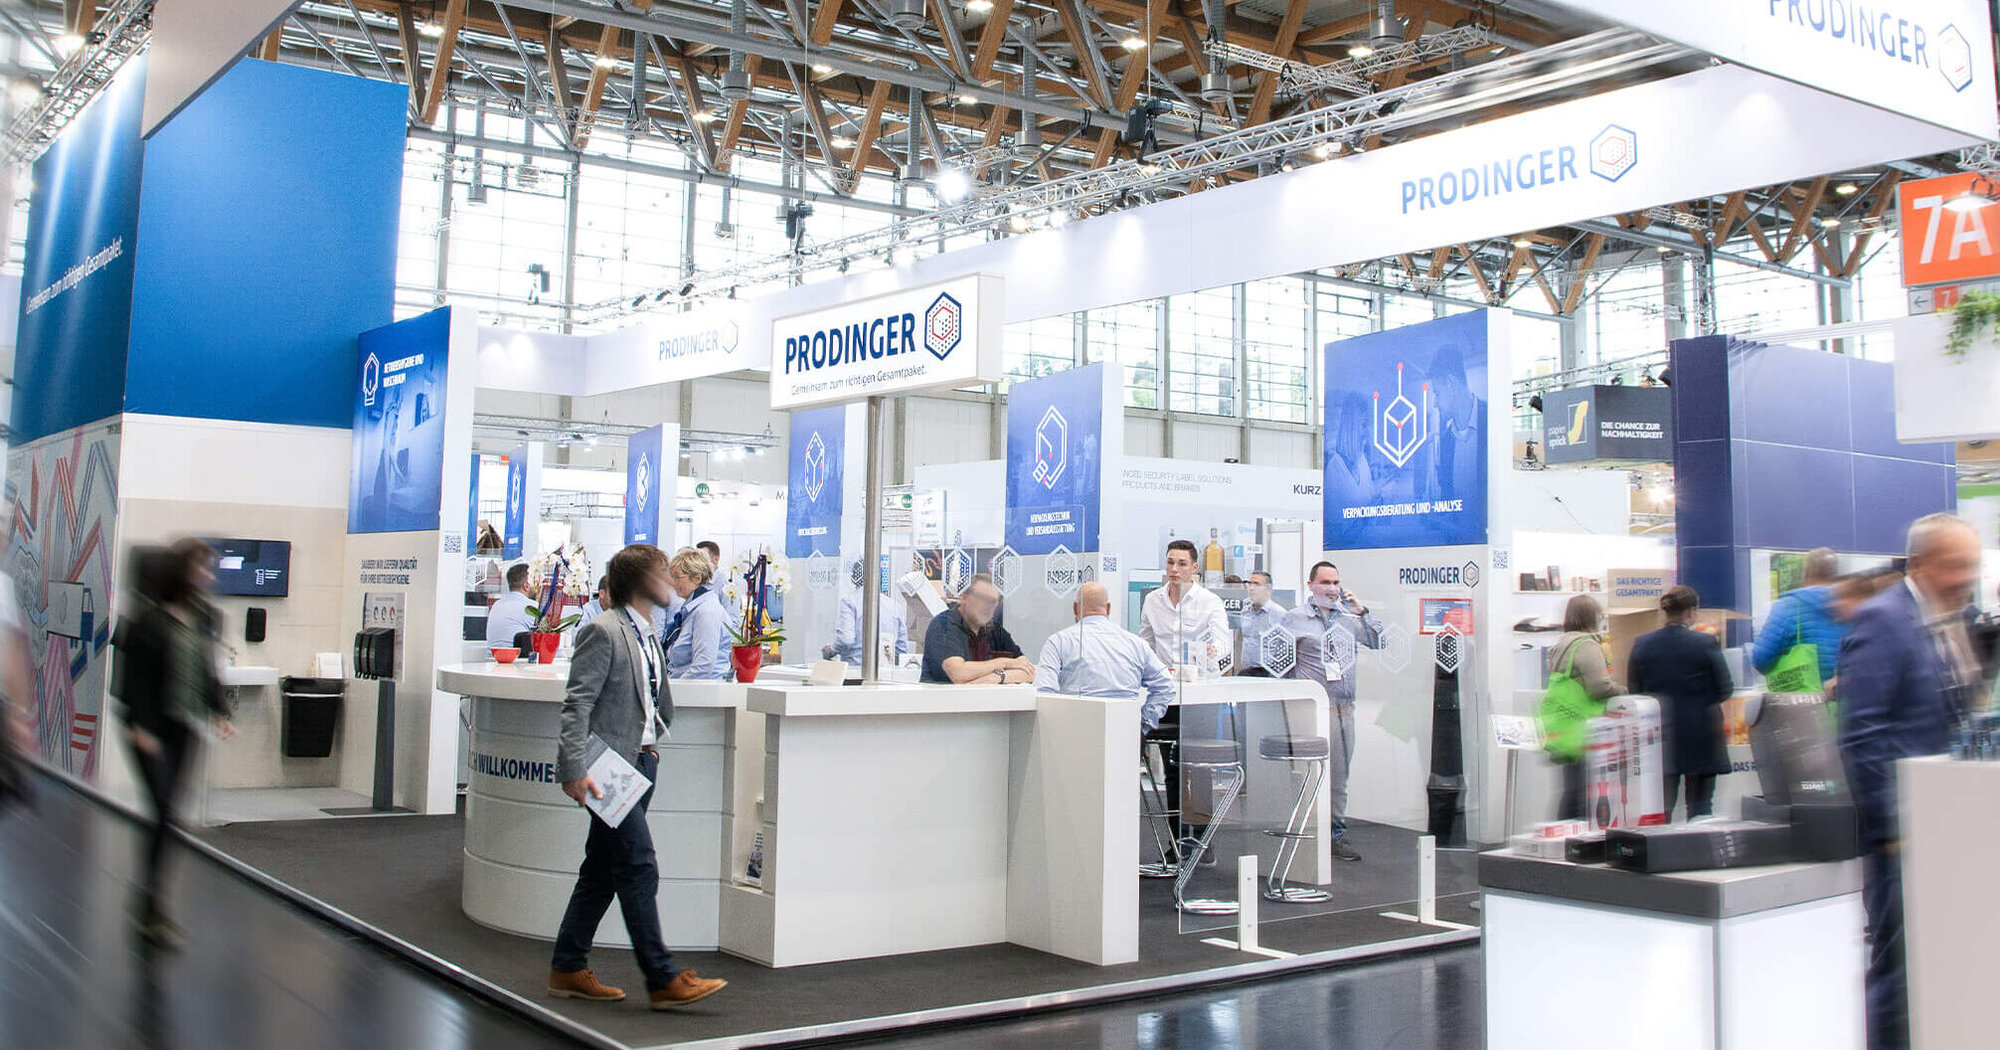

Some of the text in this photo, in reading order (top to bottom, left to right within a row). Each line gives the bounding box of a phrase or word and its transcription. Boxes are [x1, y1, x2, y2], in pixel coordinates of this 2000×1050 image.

[1402, 145, 1578, 215] PRODINGER
[1913, 195, 1993, 264] 7A
[659, 330, 719, 361] PRODINGER
[785, 312, 916, 375] PRODINGER
[791, 381, 828, 396] Gemeinsam
[829, 379, 844, 390] zum
[845, 374, 876, 387] richtigen
[1601, 421, 1661, 431] DIE CHANCE ZUR
[1601, 430, 1664, 439] NACHHALTIGKEIT
[1293, 484, 1322, 496] KURZ
[1342, 502, 1416, 519] VERPACKUNGSBERATUNG
[1416, 501, 1431, 514] UND
[1399, 566, 1460, 585] PRODINGER
[1616, 577, 1662, 586] DAS RICHTIGE
[1616, 588, 1664, 597] GESAMTPAKET
[479, 753, 556, 784] WILLKOMME
